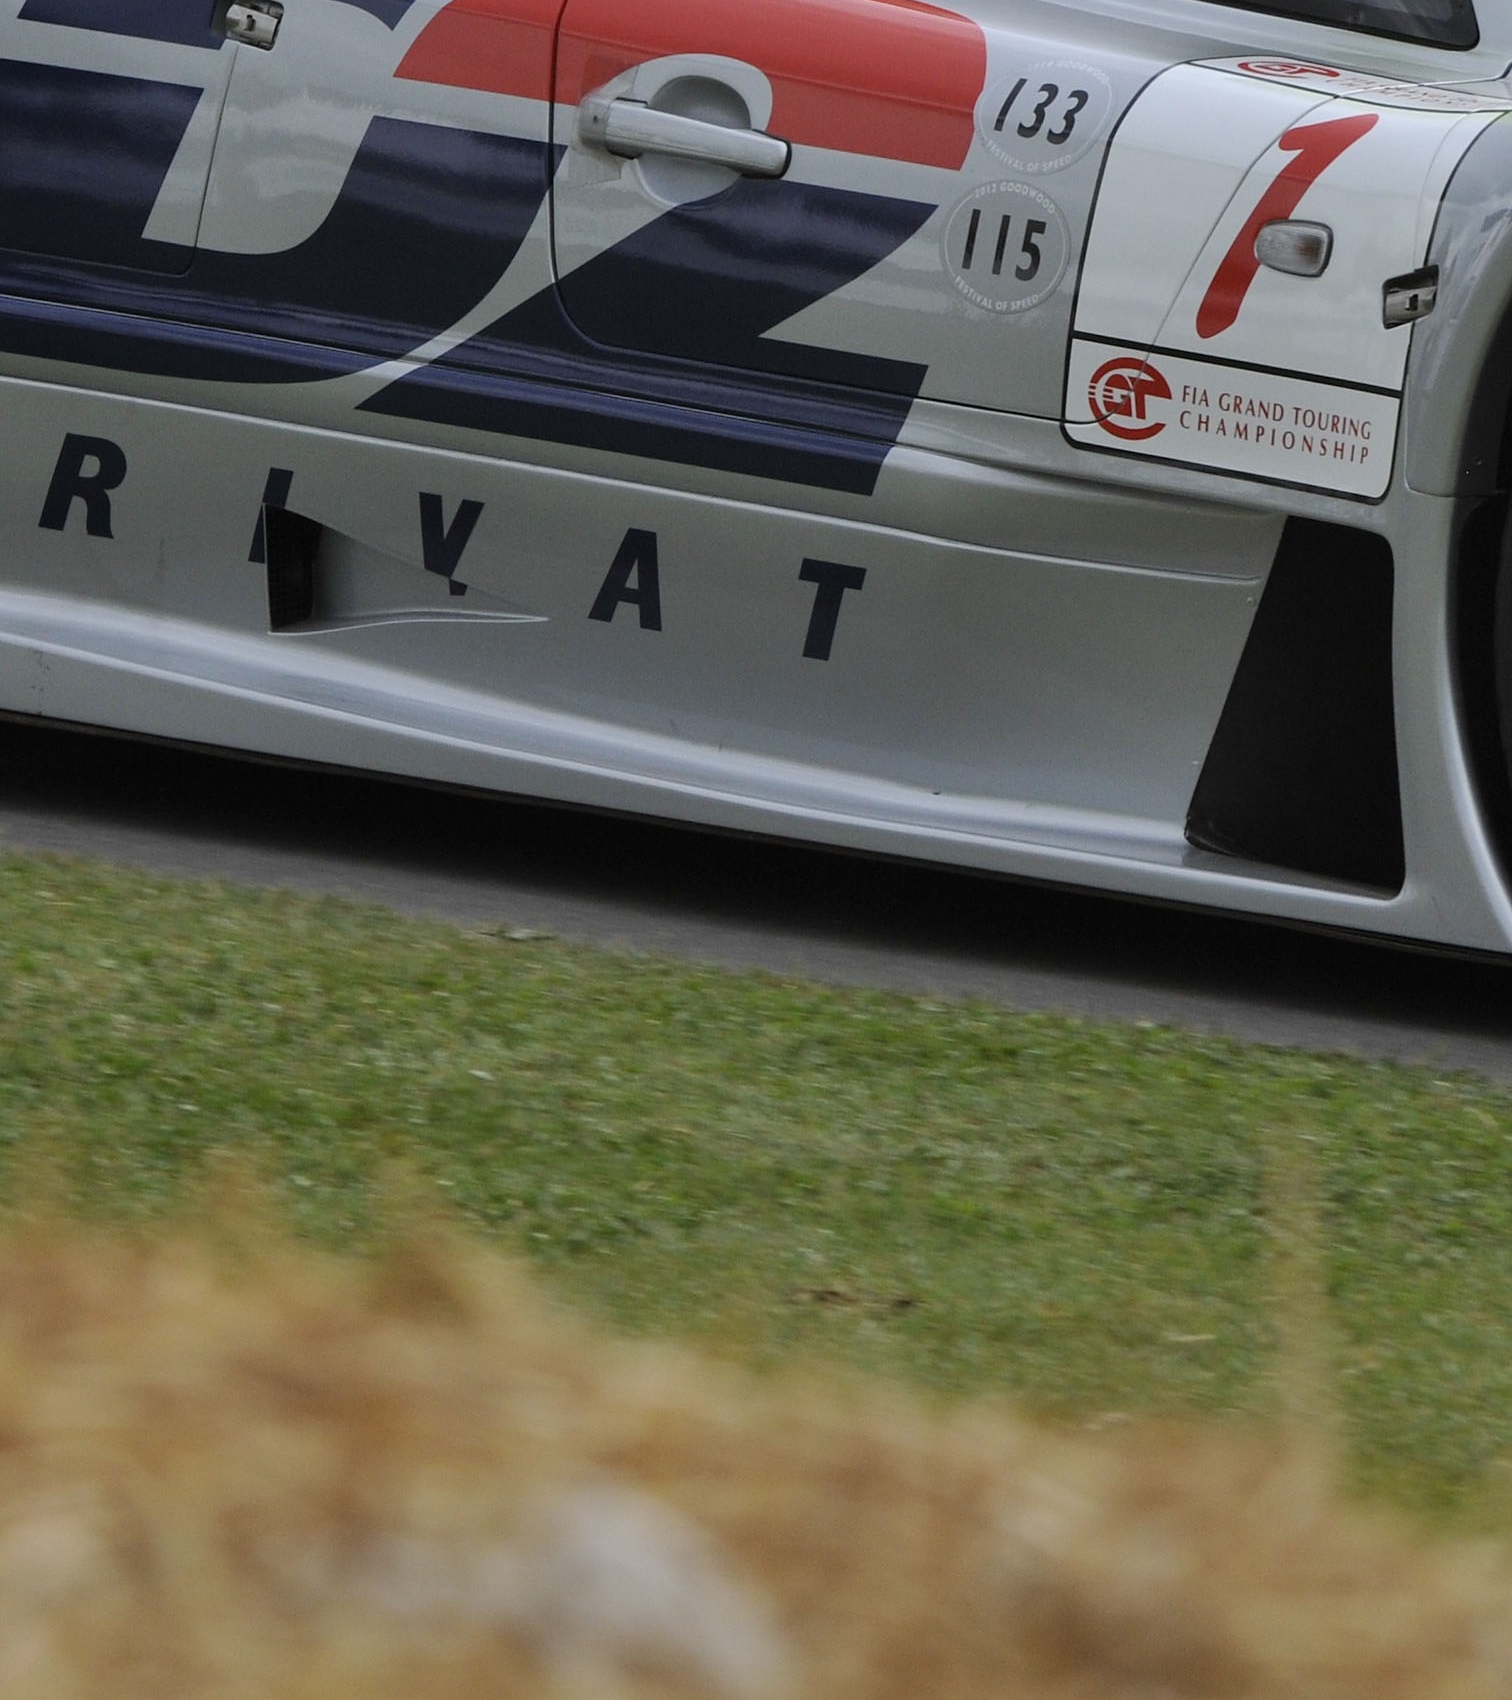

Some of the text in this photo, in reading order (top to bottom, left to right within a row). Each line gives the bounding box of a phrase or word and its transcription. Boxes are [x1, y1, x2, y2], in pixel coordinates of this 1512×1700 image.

[993, 77, 1089, 146] 133
[1041, 153, 1073, 172] SPEED
[999, 181, 1056, 214] GOODWOOD
[1194, 112, 1380, 340] 1
[961, 208, 1047, 282] 115
[954, 274, 1040, 311] FESTIVAL OF SPEED
[1179, 409, 1370, 465] CHAMPIONSHIP
[1181, 383, 1372, 441] FIA GRAND TOURING
